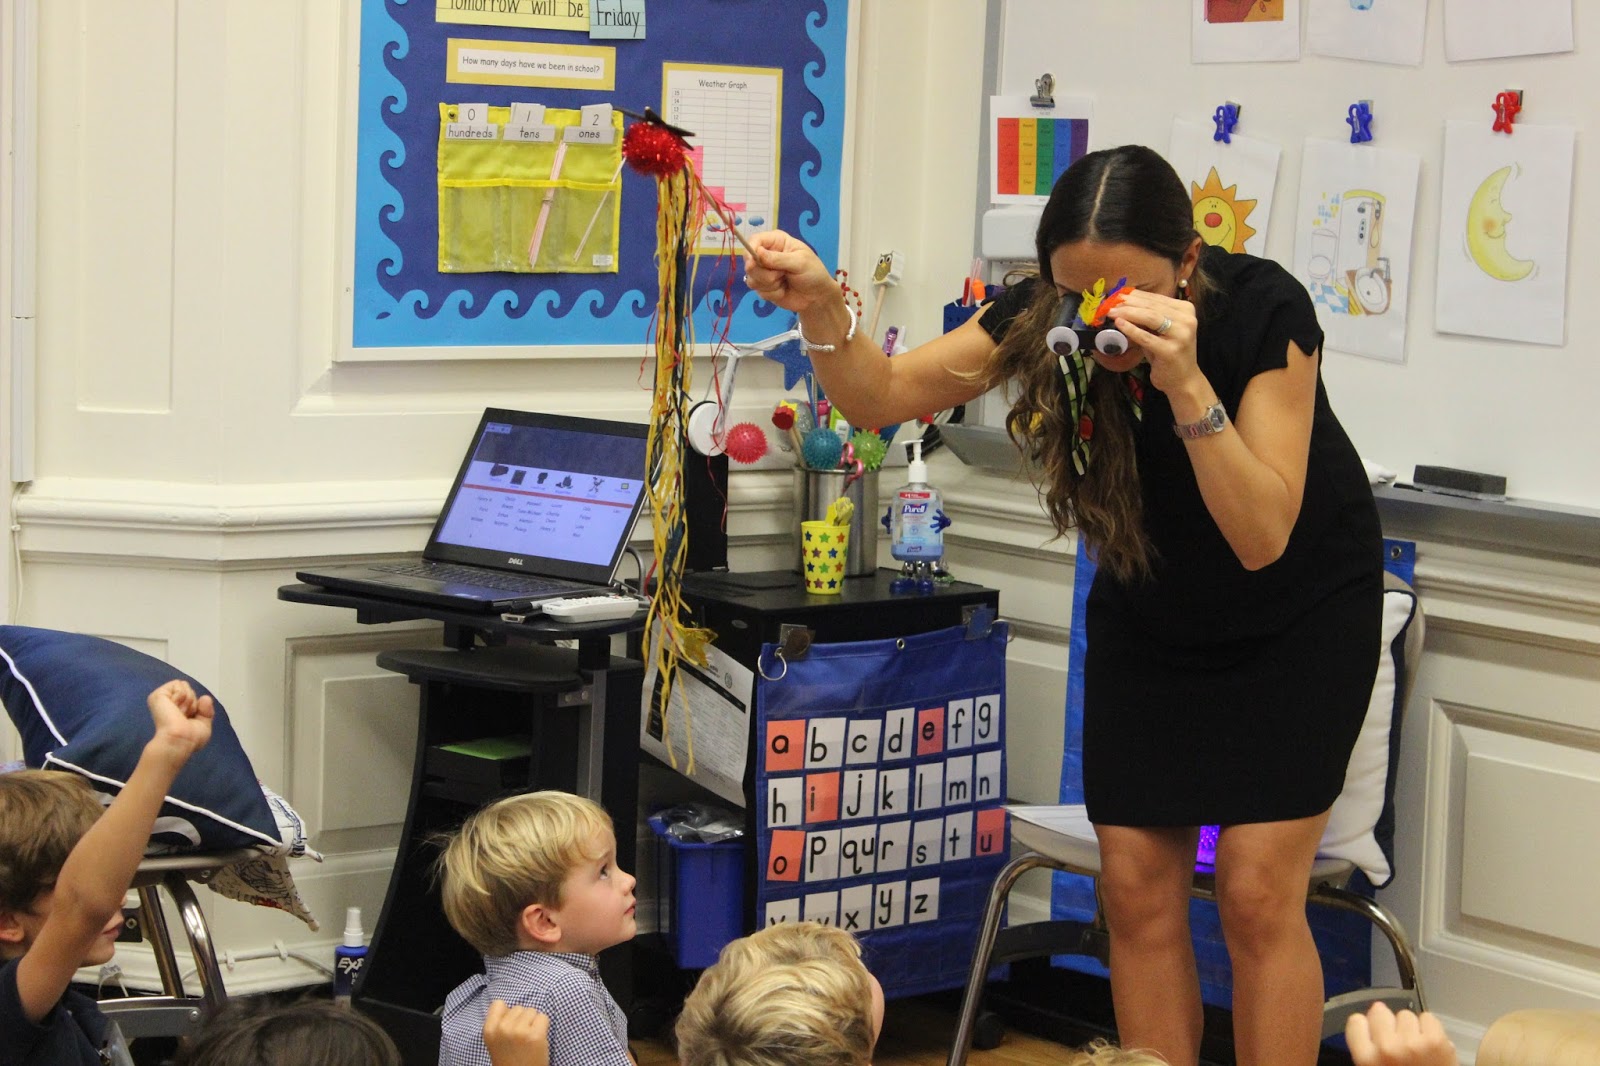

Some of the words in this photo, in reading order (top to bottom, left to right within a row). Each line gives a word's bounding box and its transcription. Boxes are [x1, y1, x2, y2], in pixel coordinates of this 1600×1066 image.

[532, 0, 556, 16] will
[568, 0, 584, 18] be
[597, 0, 640, 38] Friday
[462, 56, 478, 65] How
[480, 59, 499, 68] many
[501, 59, 517, 69] days
[519, 60, 535, 69] have
[549, 62, 566, 71] been
[567, 63, 574, 72] in
[575, 63, 600, 73] school?
[699, 79, 726, 88] Weather
[728, 81, 747, 90] Graph
[592, 114, 599, 126] 2
[448, 124, 493, 138] hundreds
[520, 128, 540, 139] tens
[579, 130, 600, 139] ones
[508, 557, 524, 565] DELL
[771, 734, 789, 754] a
[810, 727, 827, 762] b
[852, 734, 867, 753] c
[888, 717, 904, 753] d
[922, 720, 935, 740] e
[952, 708, 965, 743] f
[978, 702, 991, 739] g
[772, 787, 786, 823] h
[810, 786, 816, 811] i
[846, 774, 863, 816] j
[882, 775, 894, 810] k
[949, 780, 966, 800] m
[979, 776, 990, 796] n
[773, 856, 787, 874] o
[810, 836, 827, 873] p
[842, 840, 874, 874] qu
[882, 840, 894, 860] r
[916, 845, 926, 863] s
[948, 828, 960, 856] t
[980, 834, 991, 852] u
[845, 910, 859, 930] x
[878, 889, 892, 925] y
[914, 893, 928, 914] z
